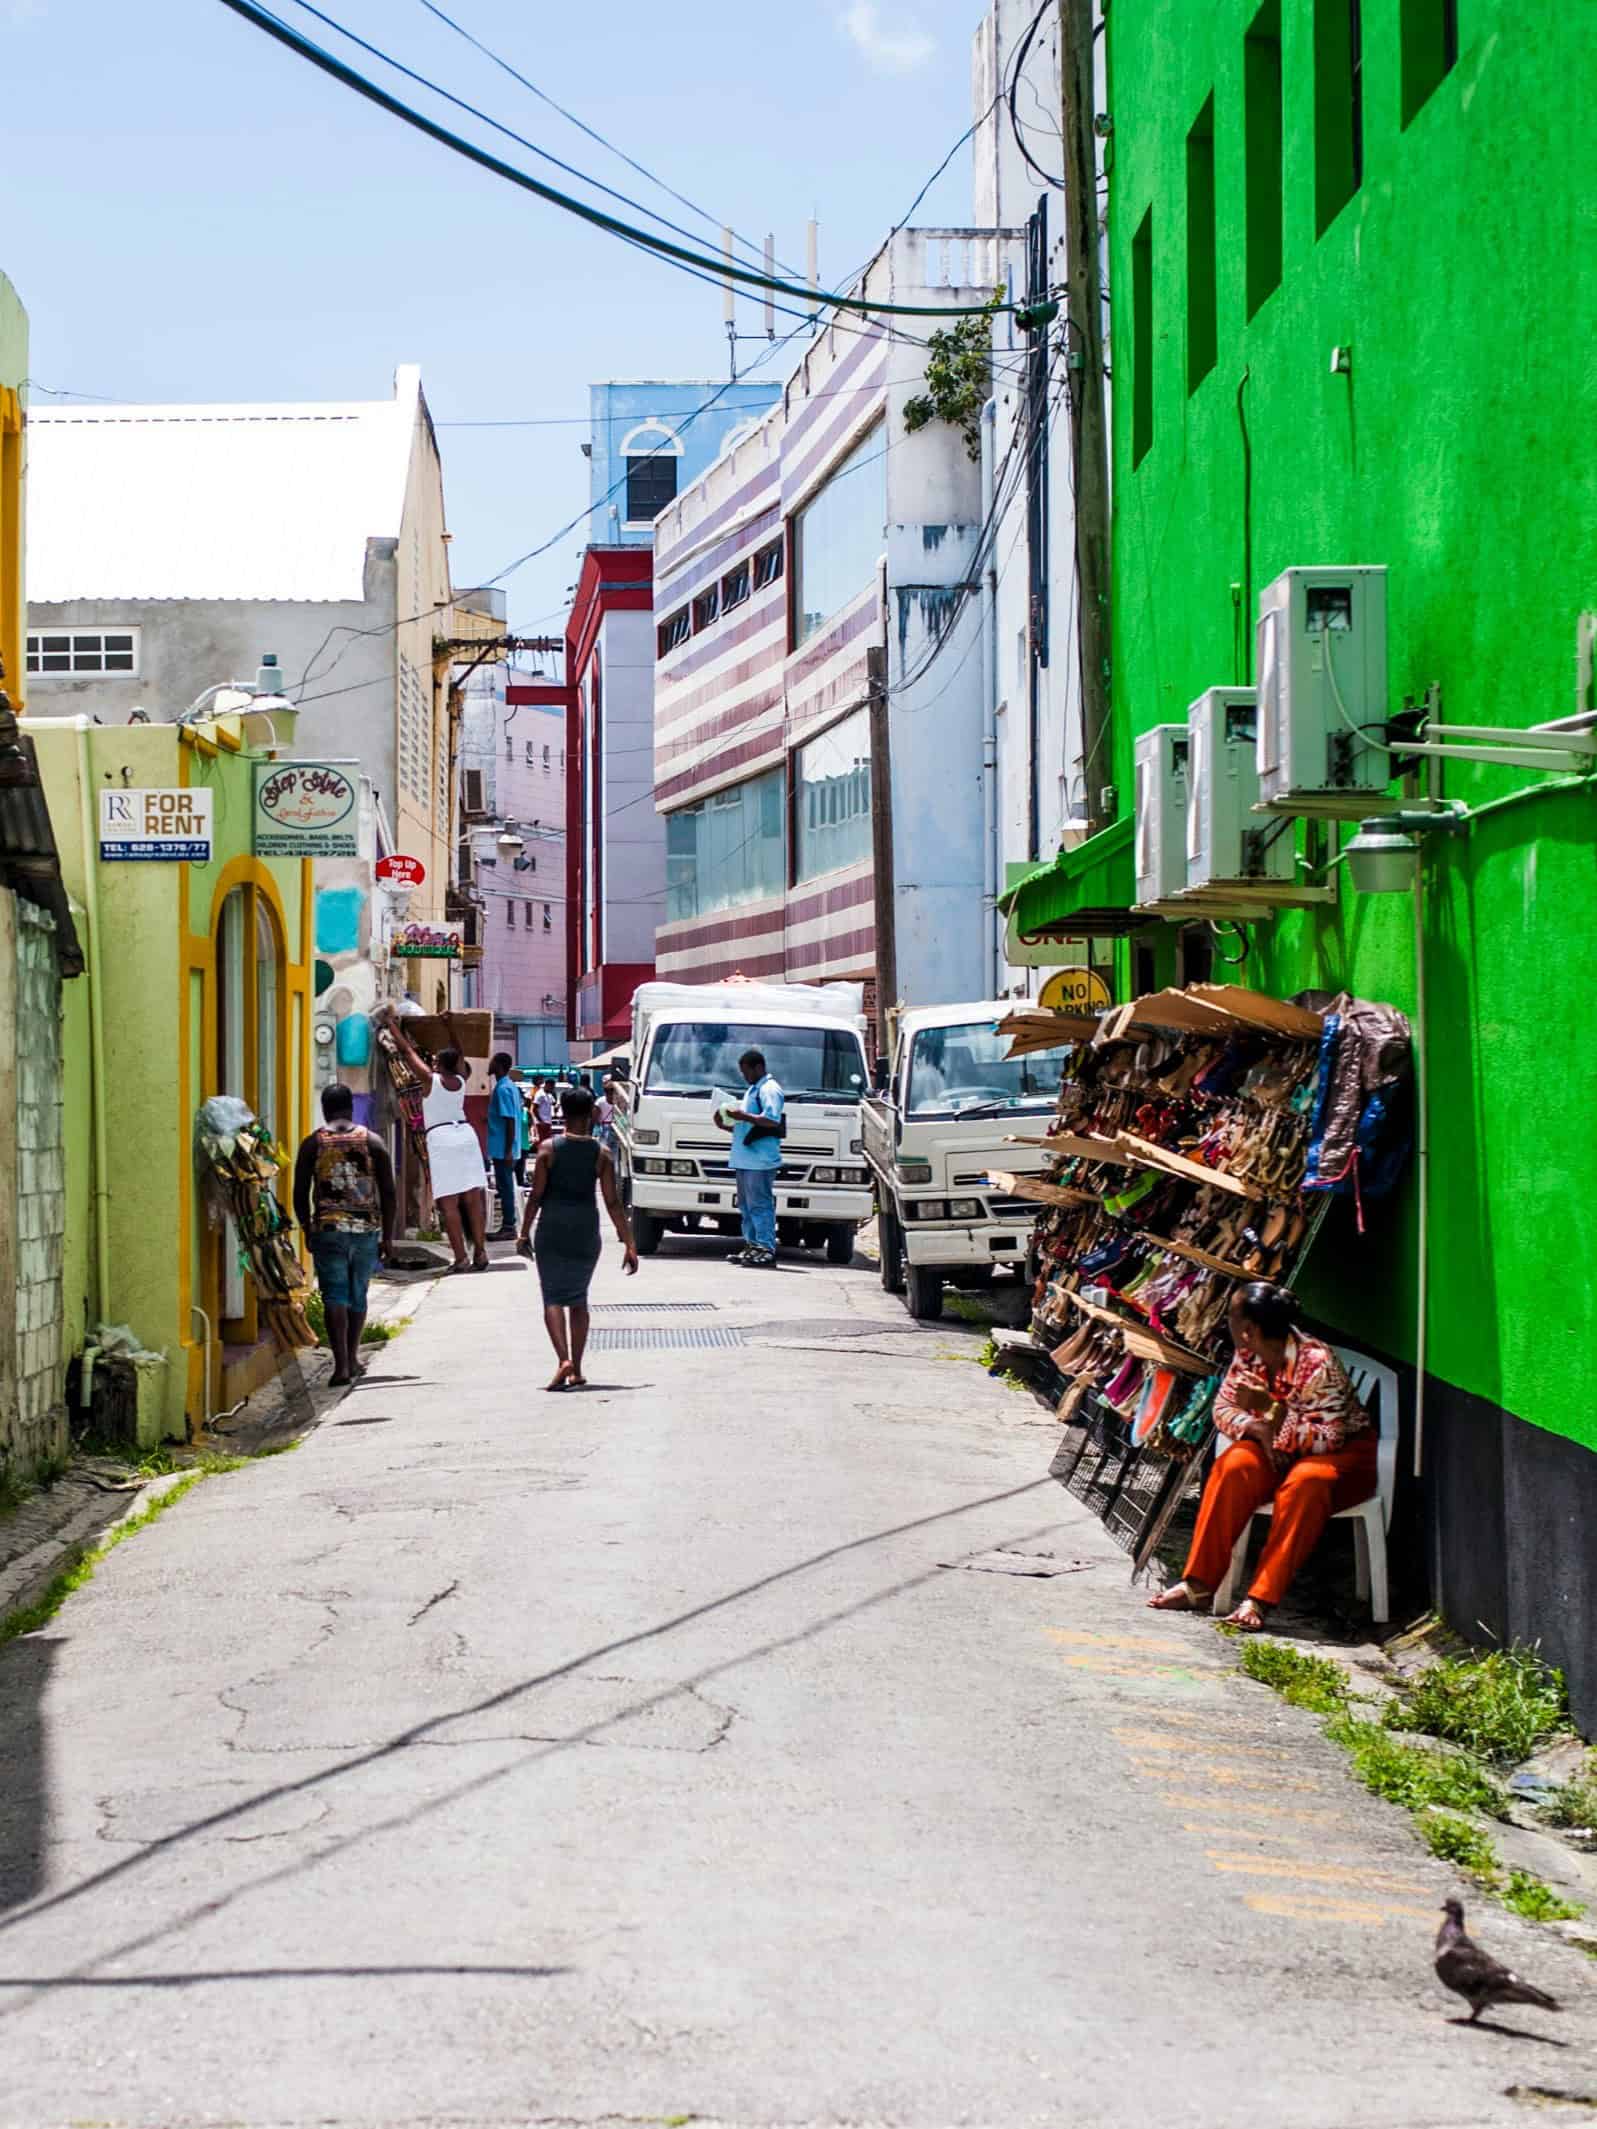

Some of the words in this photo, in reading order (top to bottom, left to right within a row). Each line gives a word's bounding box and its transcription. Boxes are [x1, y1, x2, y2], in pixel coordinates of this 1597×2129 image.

[144, 794, 193, 813] FOR
[144, 815, 206, 835] RENT
[103, 843, 127, 852] TEL:
[388, 859, 403, 870] Top
[404, 859, 417, 870] Up
[1062, 983, 1087, 1001] NO
